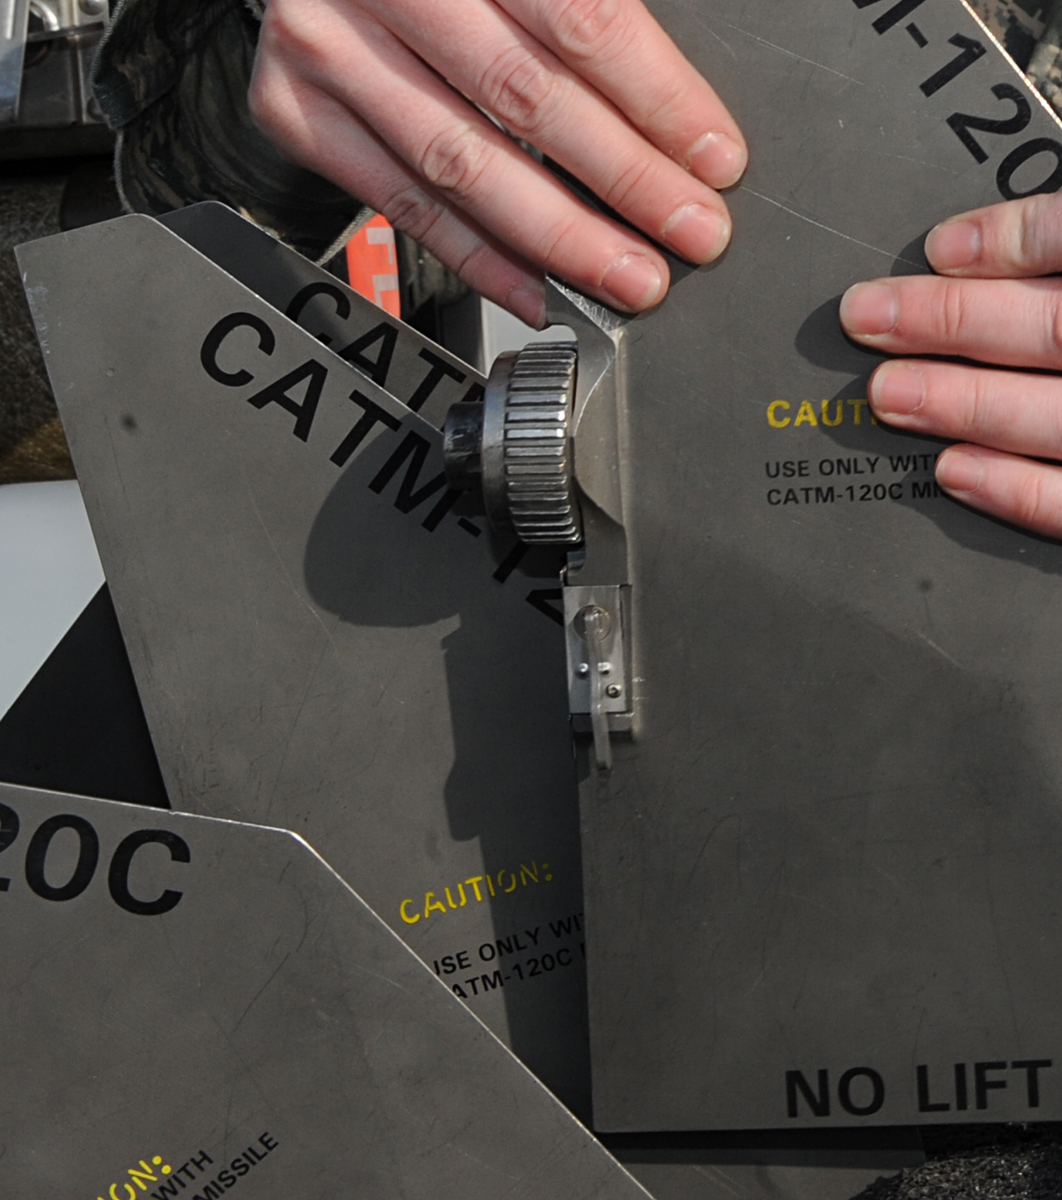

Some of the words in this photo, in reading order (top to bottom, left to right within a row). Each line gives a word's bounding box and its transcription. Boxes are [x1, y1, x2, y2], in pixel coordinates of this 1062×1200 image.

[765, 461, 810, 479] USE
[818, 456, 880, 477] ONLY
[767, 482, 903, 505] CATM-120C
[400, 860, 553, 924] CAUTION:
[478, 926, 541, 963] ONLY
[785, 1066, 886, 1118] NO
[916, 1059, 1053, 1113] LIFT
[97, 1154, 172, 1200] ON:
[150, 1149, 214, 1200] WITH
[191, 1131, 279, 1200] MISSILE
